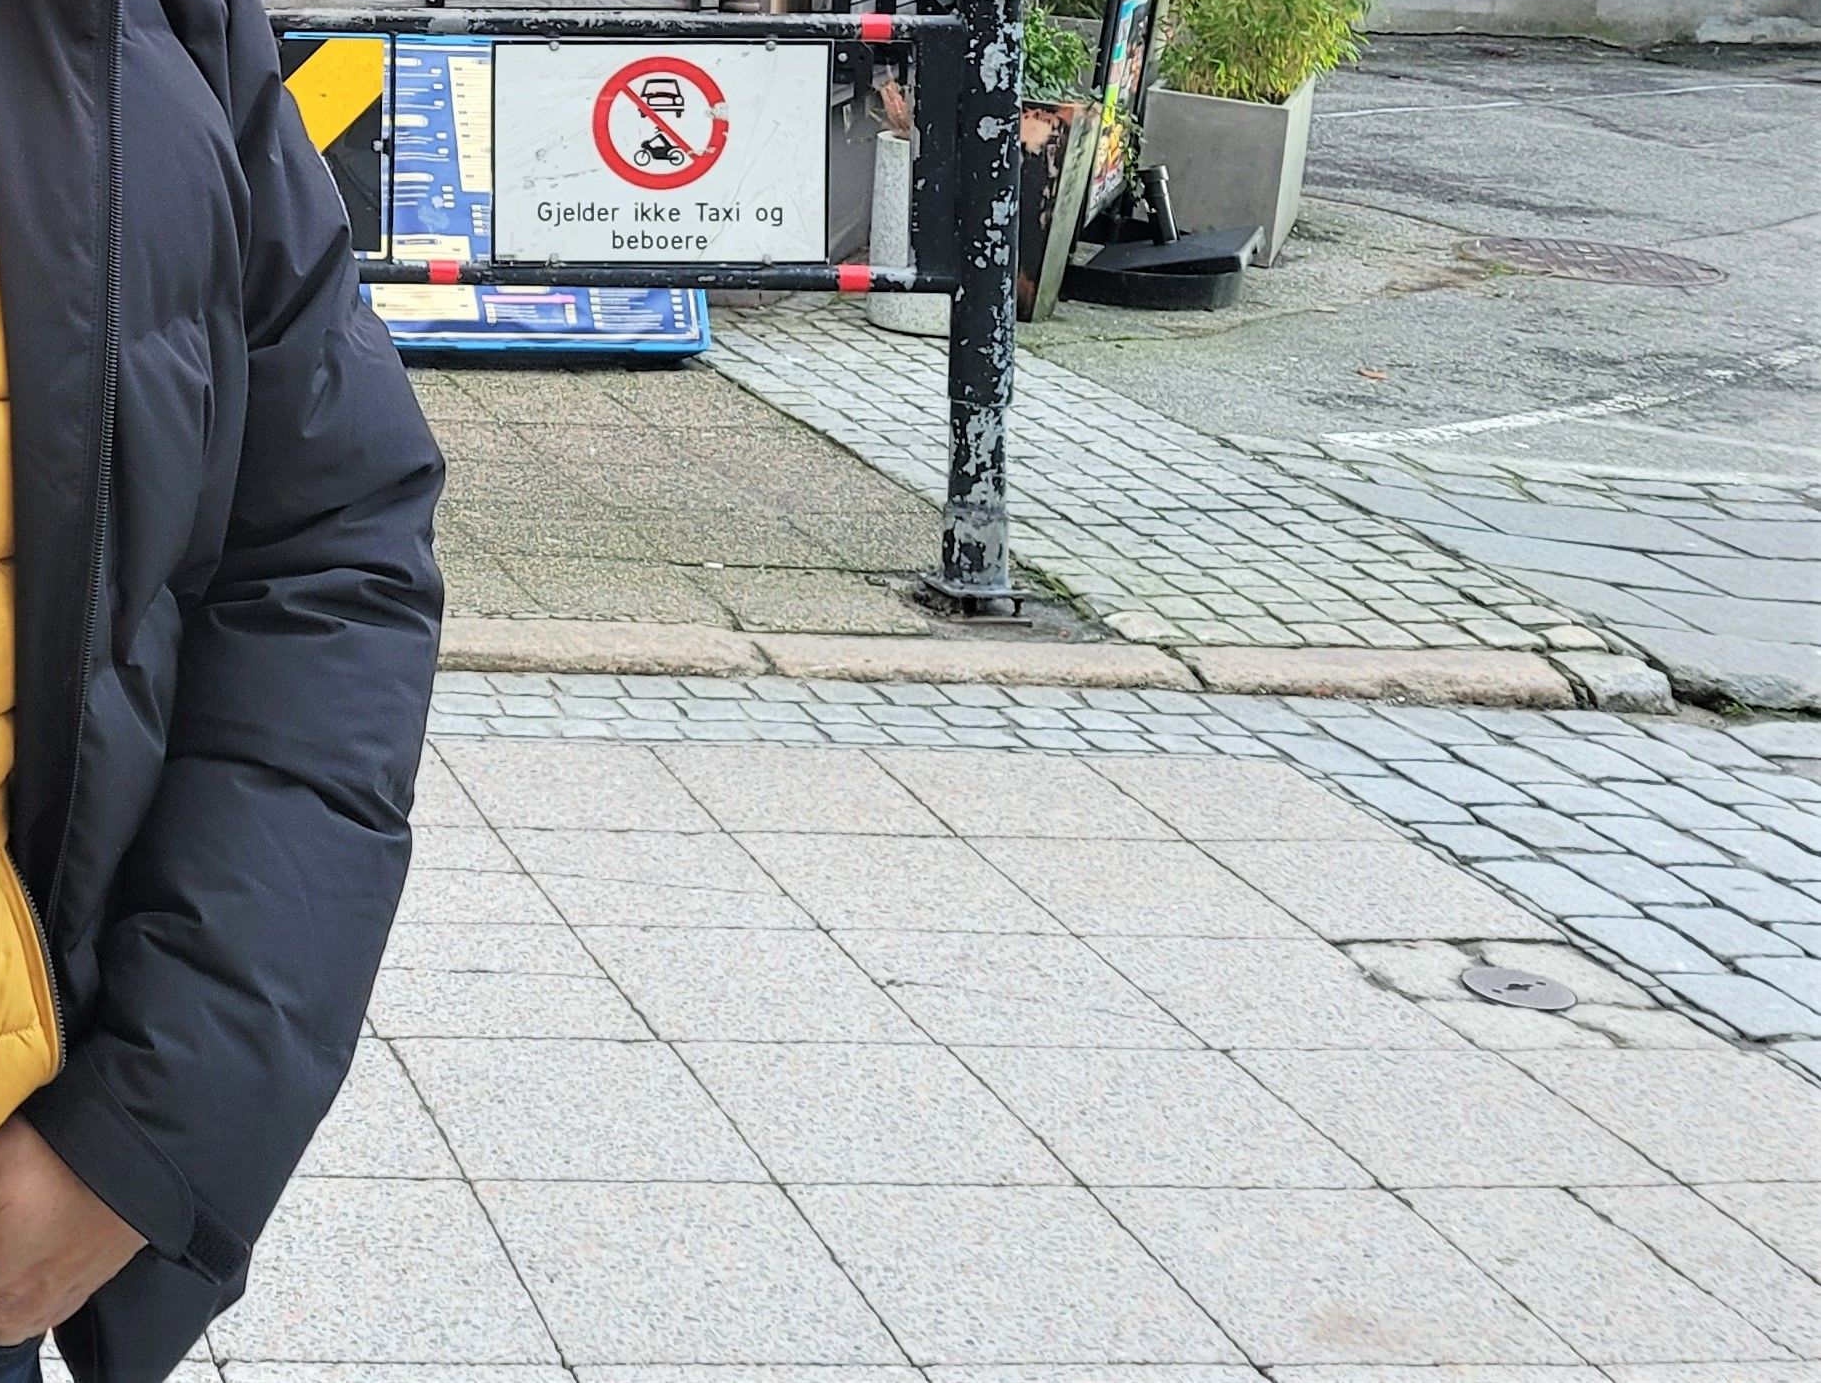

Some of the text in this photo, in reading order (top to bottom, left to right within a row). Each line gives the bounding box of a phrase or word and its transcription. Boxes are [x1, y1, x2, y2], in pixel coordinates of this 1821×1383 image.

[537, 201, 783, 227] Gjelder ikke Taxi og
[612, 230, 708, 250] beboere
